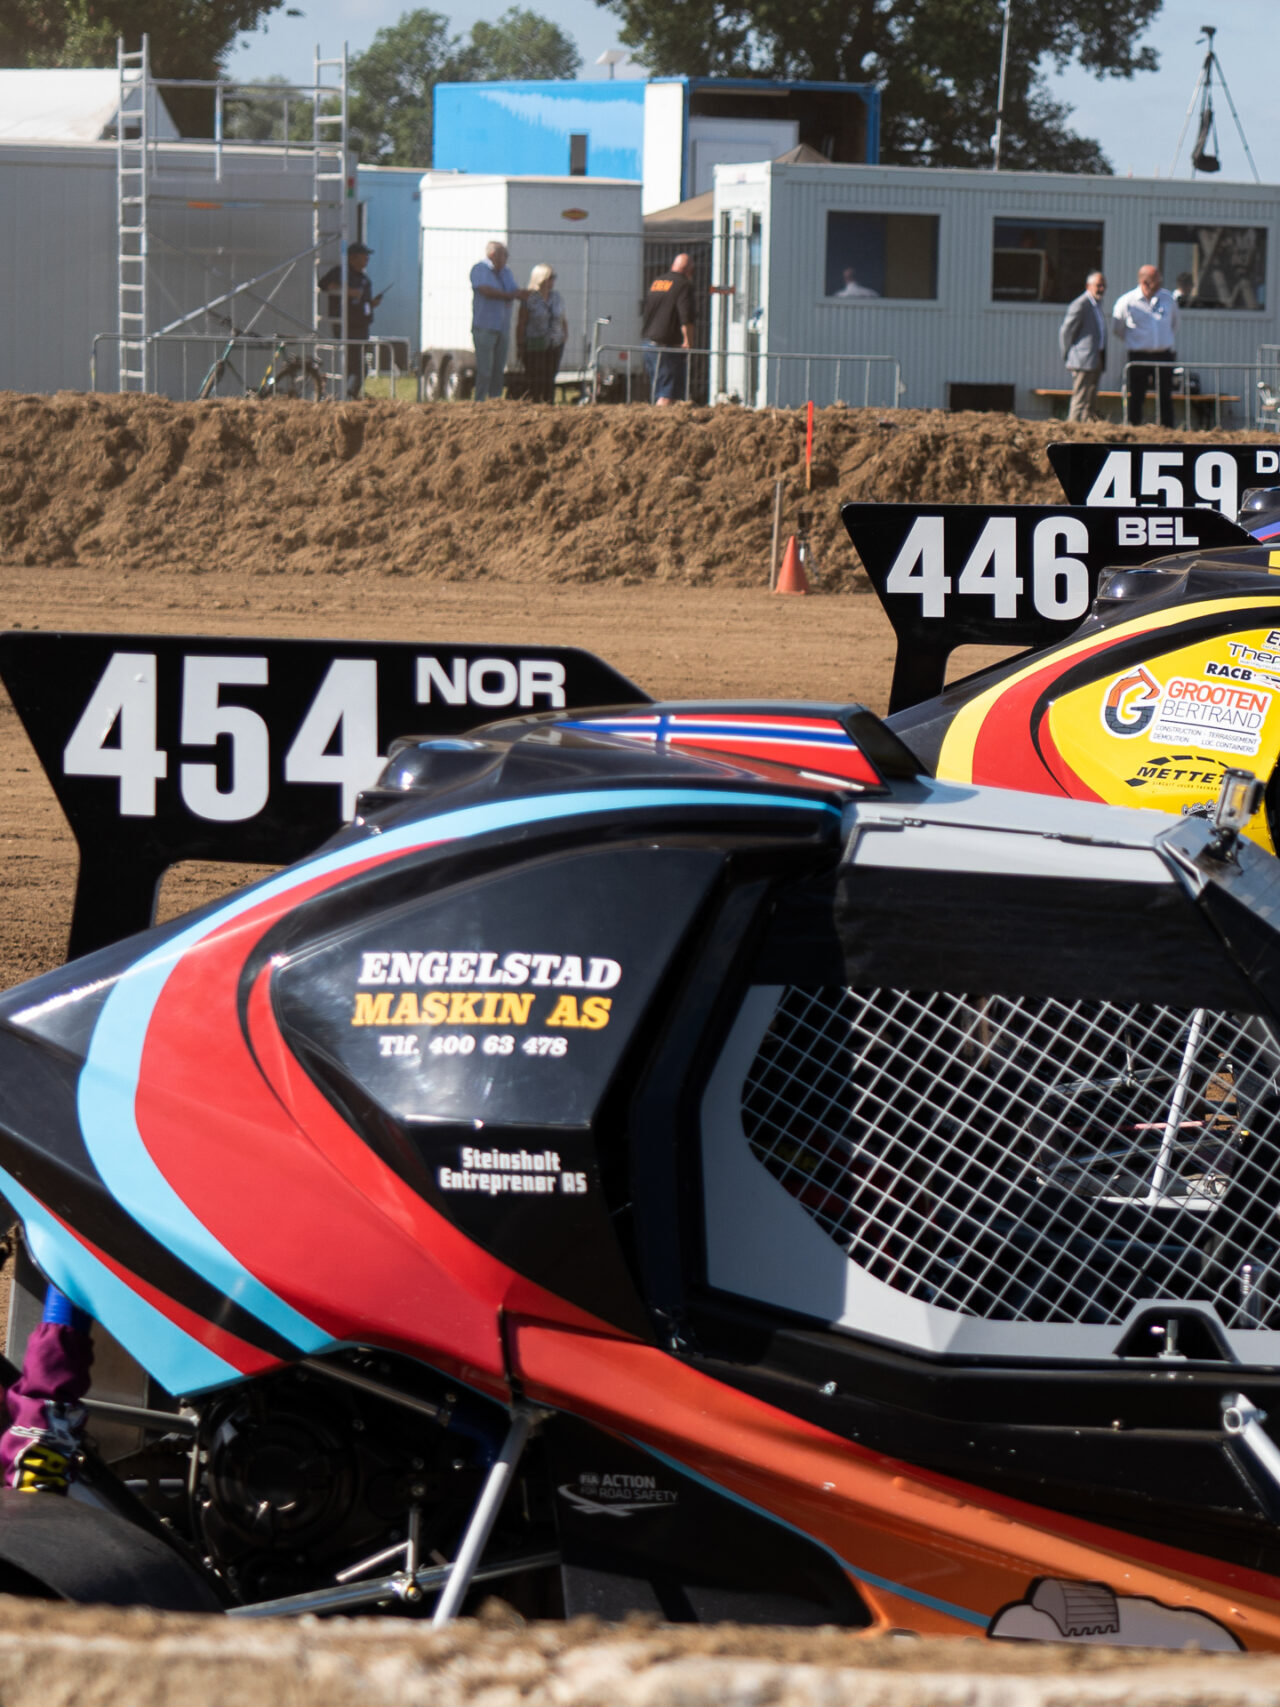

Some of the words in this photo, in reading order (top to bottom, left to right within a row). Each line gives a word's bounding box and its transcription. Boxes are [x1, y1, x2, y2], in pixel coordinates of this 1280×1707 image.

[1117, 517, 1199, 546] BEL
[886, 515, 1089, 621] 446
[416, 656, 567, 708] NOR
[1205, 662, 1253, 681] RACB
[1167, 680, 1268, 713] GROOTEN
[1161, 699, 1262, 729] BERTRAND
[64, 652, 388, 822] 454
[358, 951, 622, 990] ENGELSTAD
[352, 992, 536, 1027] MASKIN
[546, 994, 613, 1029] AS
[428, 1034, 476, 1056] 400
[482, 1034, 515, 1056] 63
[522, 1035, 568, 1057] 478
[462, 1146, 561, 1172] Steinsholt
[562, 1171, 587, 1194] AS
[599, 1487, 632, 1500] ROAD
[633, 1489, 679, 1501] SAFETY
[602, 1473, 656, 1489] ACTION
